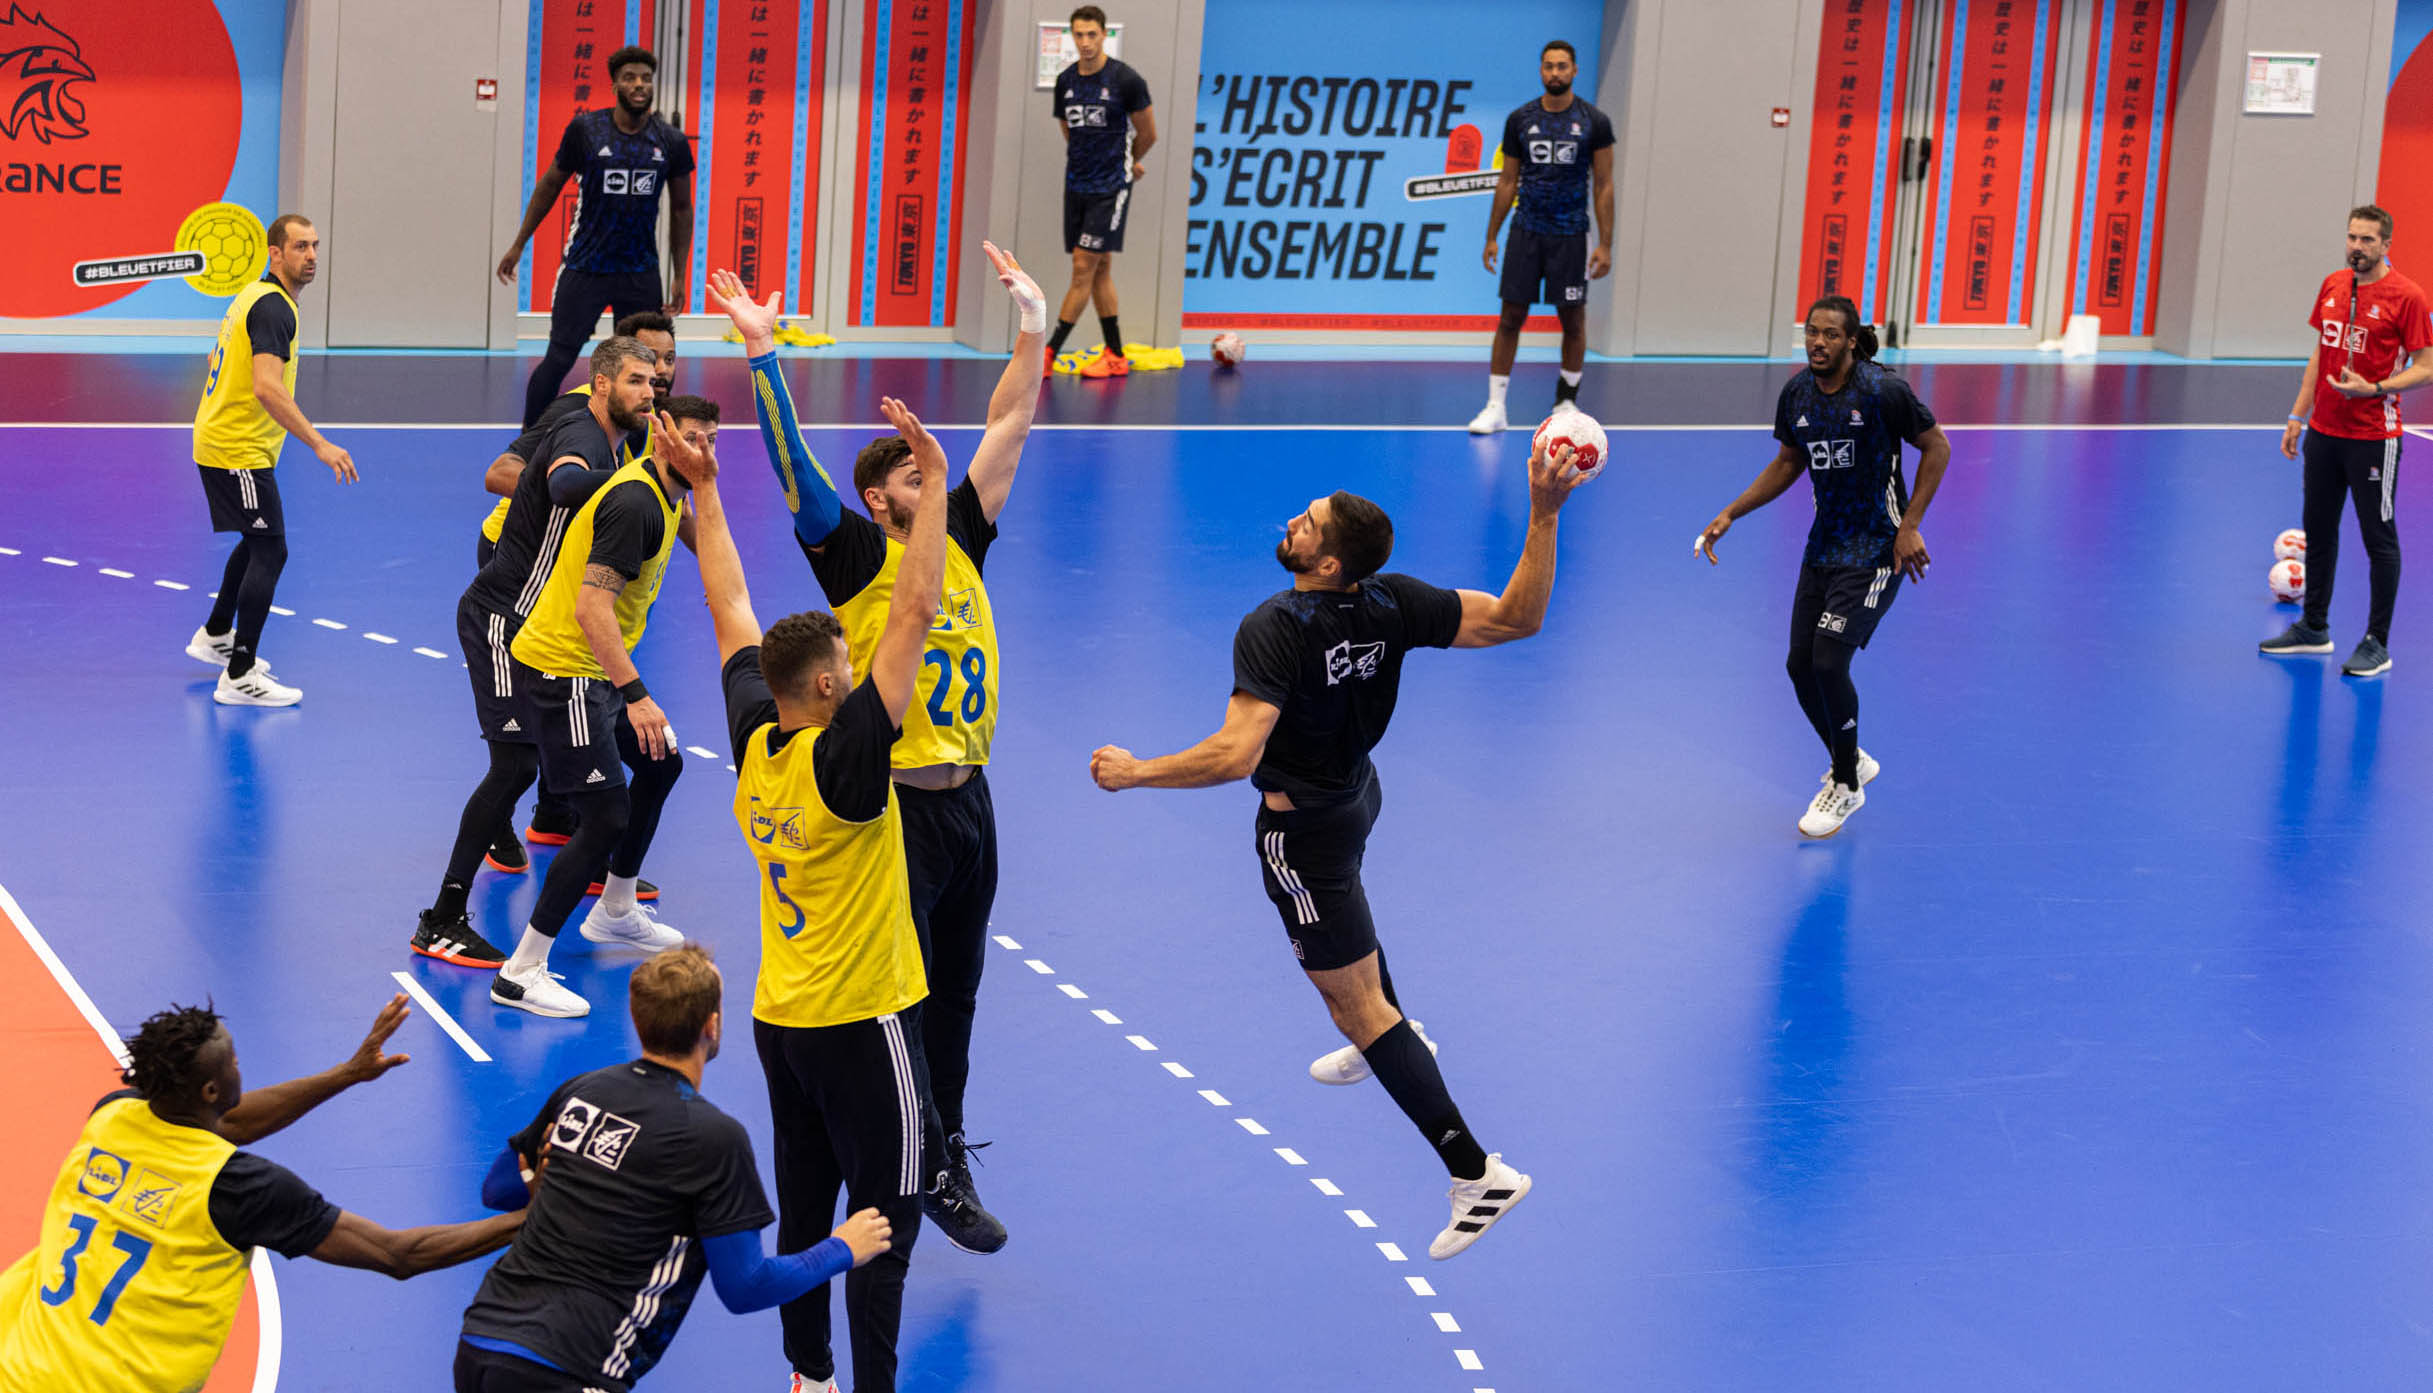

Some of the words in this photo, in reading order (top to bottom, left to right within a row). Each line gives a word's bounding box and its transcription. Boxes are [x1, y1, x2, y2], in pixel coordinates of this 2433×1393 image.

[1195, 74, 1473, 138] 'HISTOIRE
[1414, 175, 1500, 195] #BLEUETFIE
[84, 257, 196, 279] #BLEUETFIER
[924, 647, 987, 727] 28
[768, 862, 806, 940] 5
[40, 1211, 154, 1327] 37
